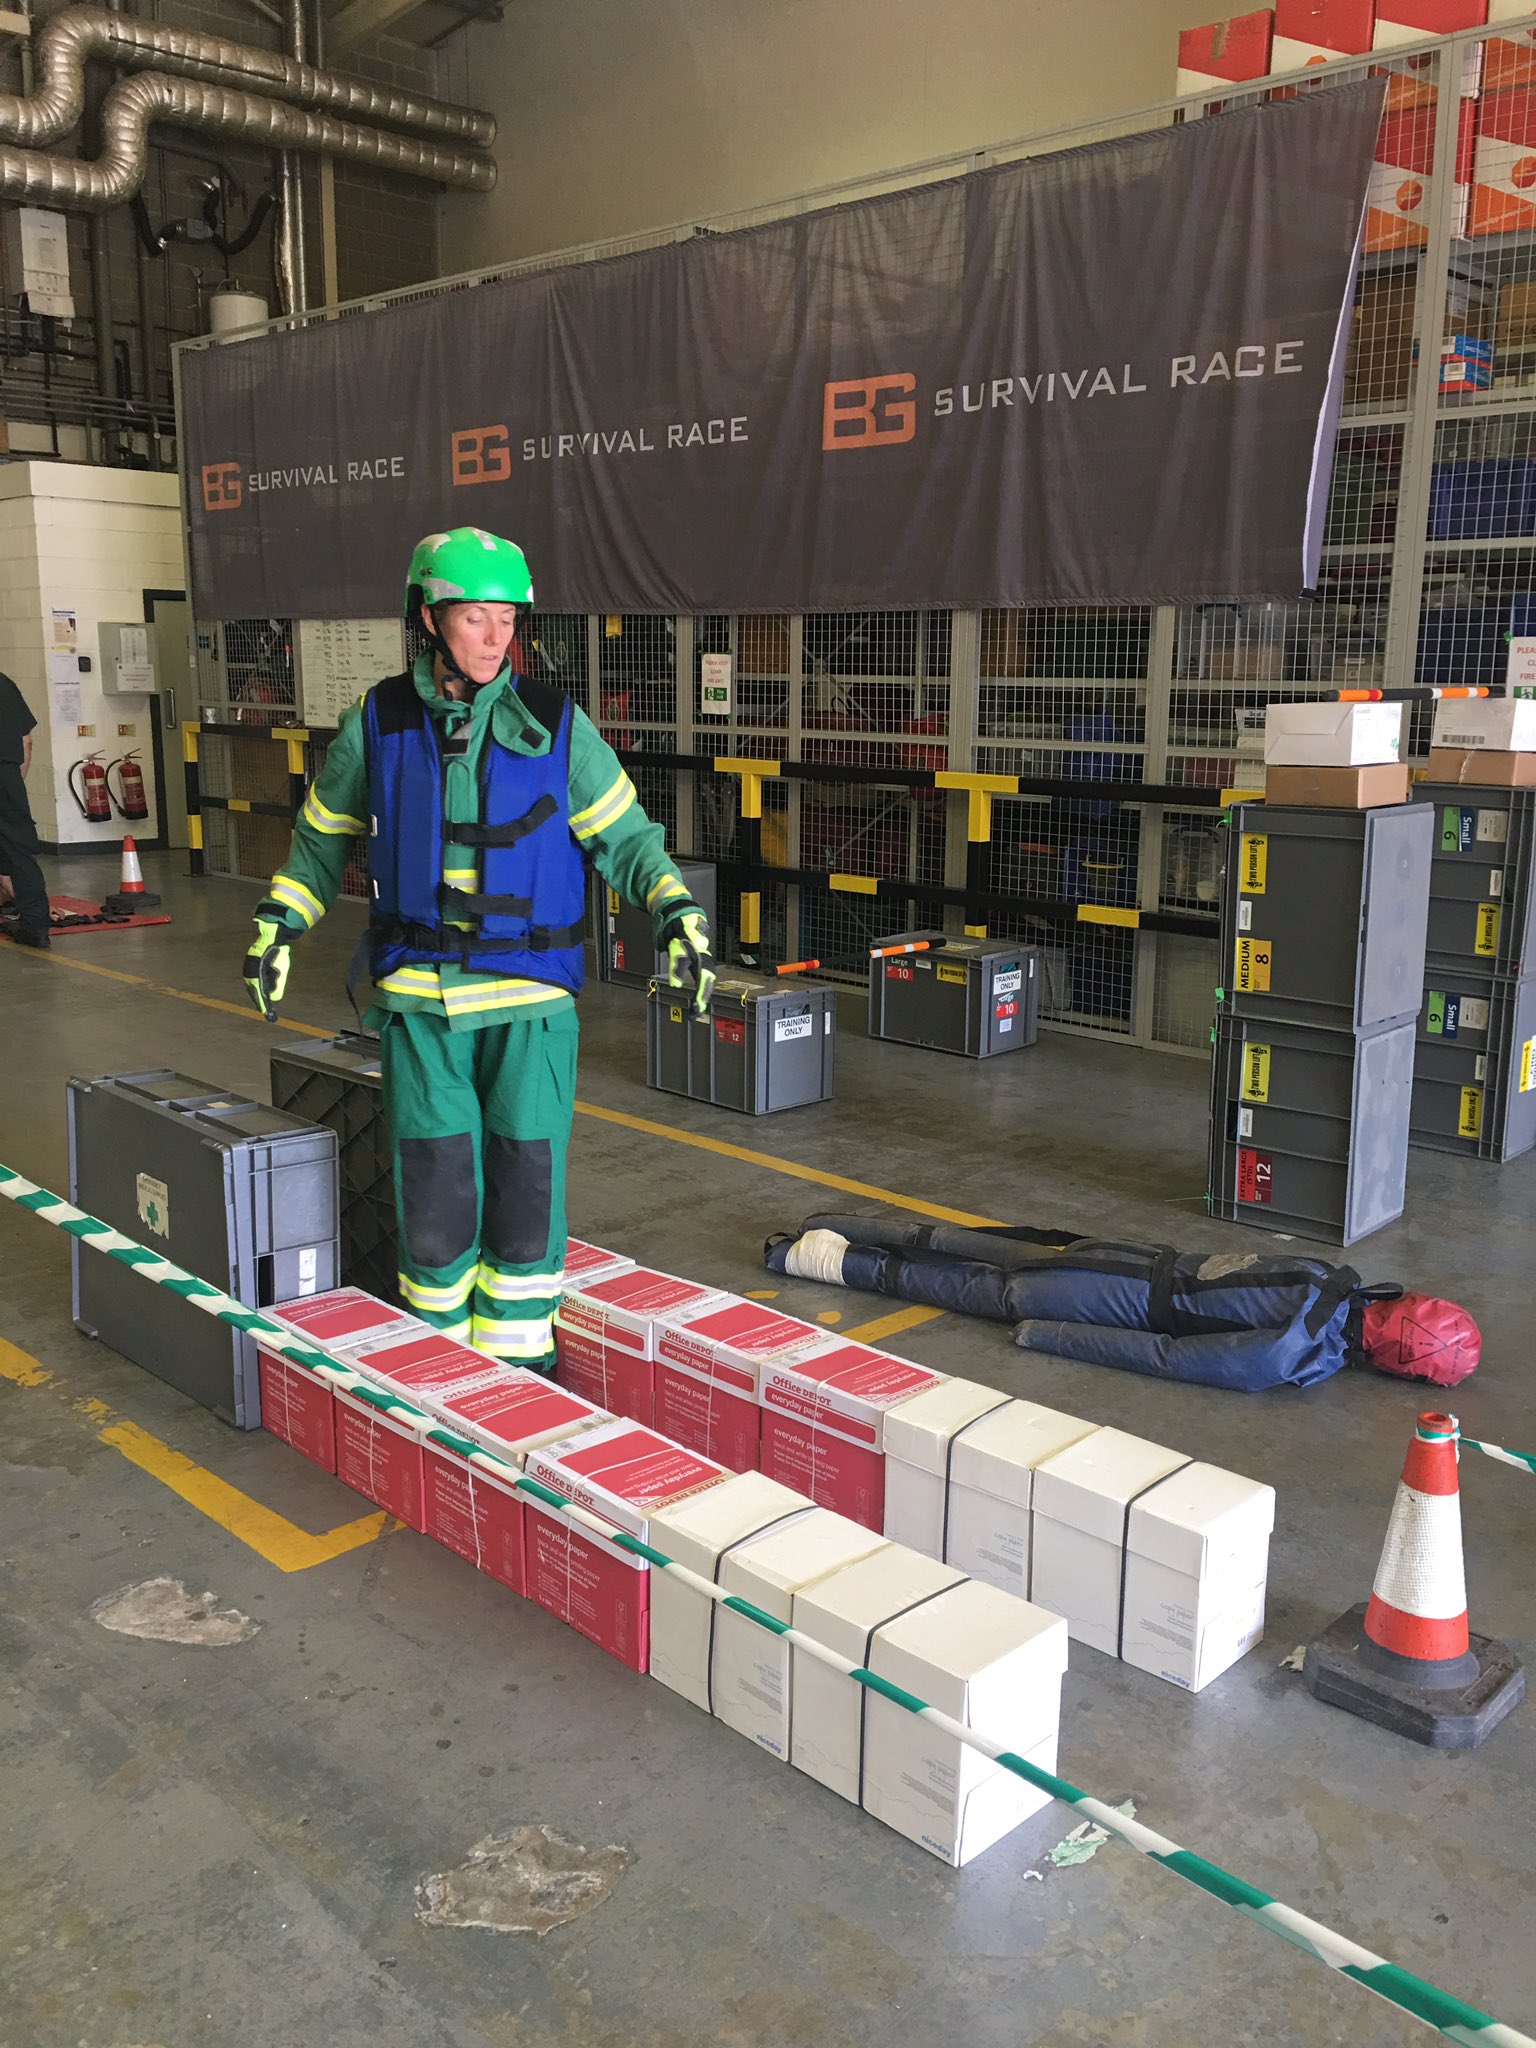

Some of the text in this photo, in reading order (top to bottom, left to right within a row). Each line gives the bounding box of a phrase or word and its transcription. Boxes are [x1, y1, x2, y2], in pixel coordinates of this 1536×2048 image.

[822, 341, 1304, 451] BG SURVIVAL RACE
[452, 417, 749, 486] BG SURVIVAL RACE
[202, 456, 404, 511] BG SURVIVAL RACE
[1462, 816, 1472, 844] Small
[1250, 854, 1258, 870] PERSON
[891, 956, 908, 966] Large
[1240, 940, 1250, 988] MEDIUM
[1255, 954, 1269, 964] 8
[898, 968, 908, 979] 10
[996, 972, 1020, 984] TRAINING
[1000, 982, 1014, 990] ONLY
[1005, 1004, 1014, 1014] 10
[1446, 1004, 1457, 1031] Small
[777, 1016, 810, 1030] TRAINING
[784, 1028, 803, 1037] ONLY
[732, 1033, 740, 1042] 12
[1256, 1163, 1270, 1182] 12
[564, 1295, 610, 1320] Office DEPOT
[563, 1311, 588, 1328] everyday
[565, 1338, 590, 1354] everyday
[665, 1329, 690, 1346] Office
[664, 1346, 710, 1370] everyday paper
[664, 1377, 711, 1402] everyday paper
[772, 1375, 802, 1394] Office
[772, 1392, 824, 1420] everyday paper
[344, 1412, 368, 1432] everyday
[774, 1428, 828, 1456] everyday paper
[435, 1466, 460, 1488] everyday
[536, 1464, 567, 1489] Office
[664, 1466, 702, 1484] everyday
[537, 1524, 588, 1561] everyday paper
[1161, 1670, 1190, 1688] niceday
[756, 1734, 782, 1754] niceday
[922, 1834, 951, 1858] niceday
